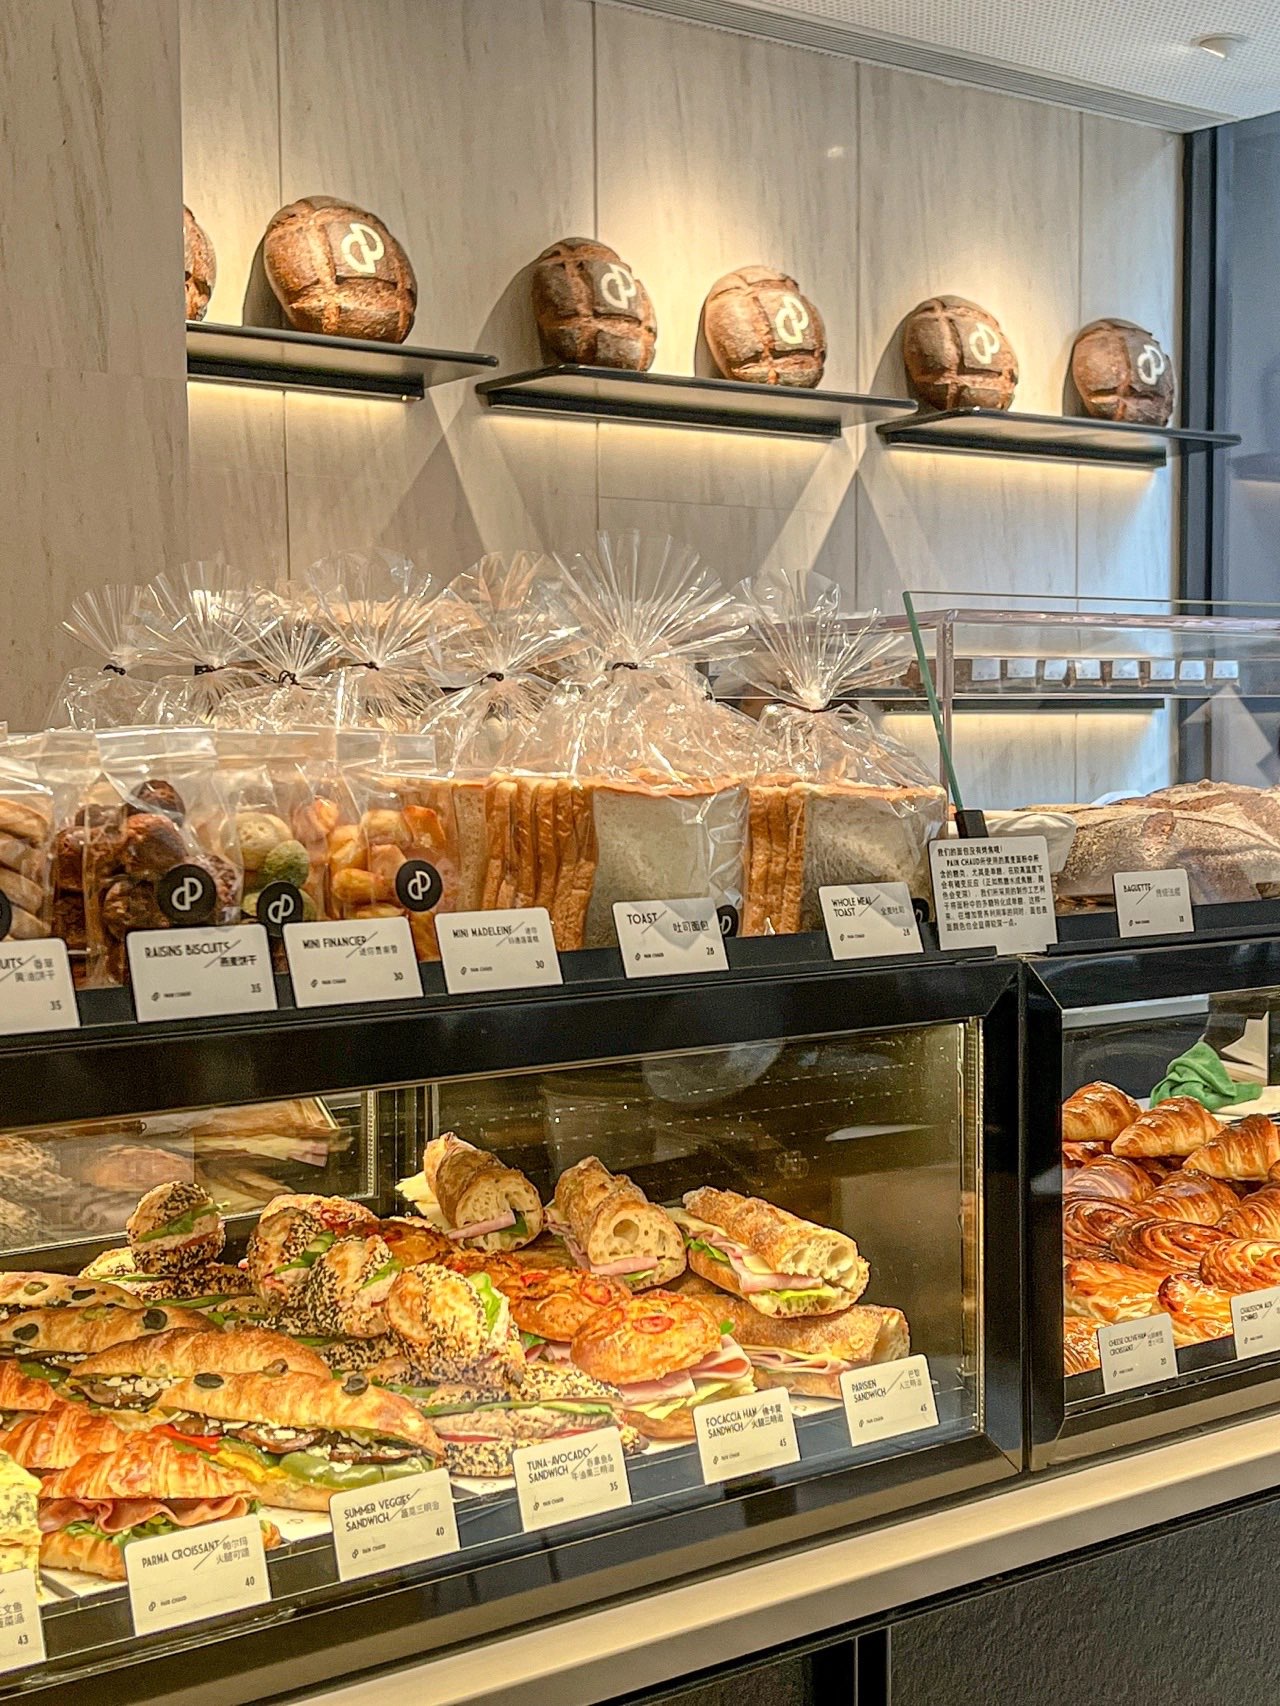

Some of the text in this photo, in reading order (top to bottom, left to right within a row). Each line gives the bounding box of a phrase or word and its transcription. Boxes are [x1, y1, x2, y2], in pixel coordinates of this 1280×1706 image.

[1123, 883, 1151, 893] BAGUETTE
[831, 896, 872, 907] WHOLE MEAL
[627, 912, 657, 925] TOAST
[833, 907, 856, 917] TOAST
[452, 925, 512, 938] MINI MADELEINE
[673, 920, 709, 933] 吐司面包
[302, 935, 367, 949] MINI FINANCIER
[145, 942, 230, 958] RAISINS BISCUITS
[535, 960, 545, 969] 30
[393, 971, 404, 981] 30
[851, 1378, 877, 1392] PARISIEN
[853, 1387, 887, 1403] SANDWICH
[920, 1403, 927, 1412] 45
[705, 1406, 757, 1428] FOCACCIA HAM
[708, 1422, 744, 1439] SANDWICH
[779, 1438, 787, 1447] 45
[527, 1447, 591, 1472] TUNA-AVOCADO
[528, 1464, 569, 1484] SANDWICH
[609, 1481, 619, 1491] 35
[344, 1493, 411, 1520] SUMMER VEGGIES
[345, 1511, 390, 1532] SANDWICH
[435, 1526, 445, 1536] 40
[142, 1539, 220, 1568] PARMA CROISSANT
[245, 1576, 255, 1586] 40
[17, 1634, 29, 1645] 43
